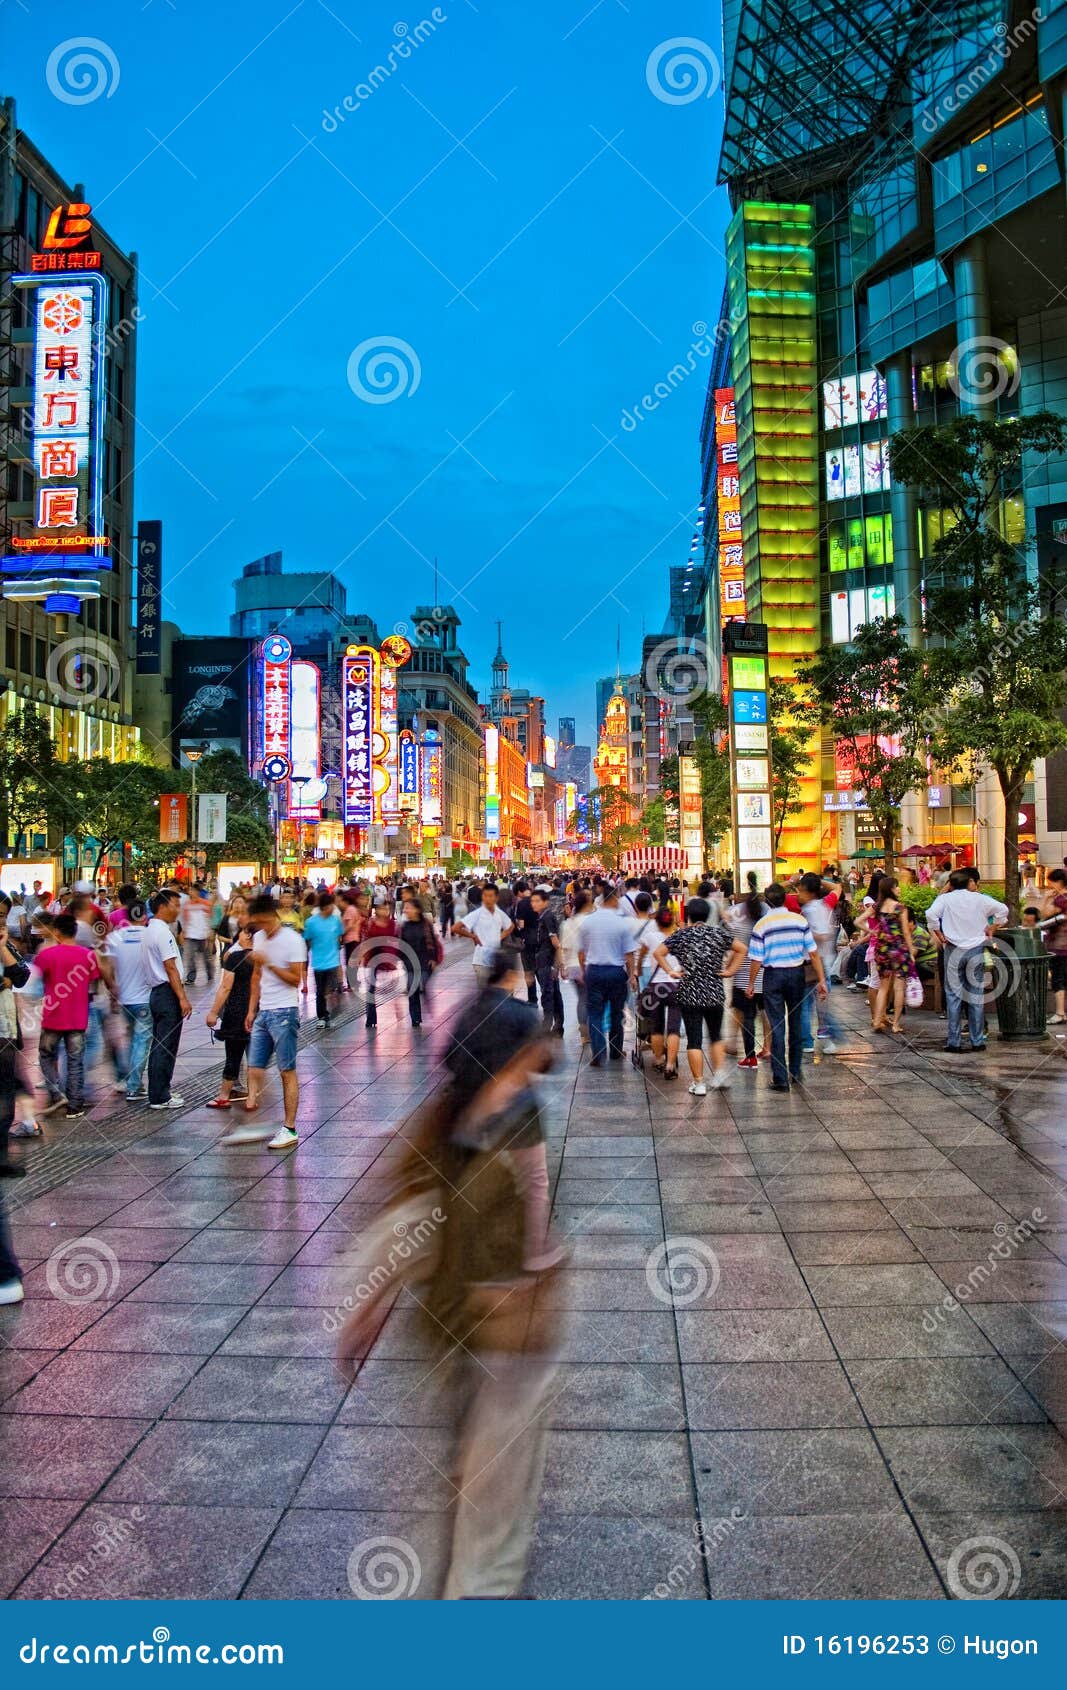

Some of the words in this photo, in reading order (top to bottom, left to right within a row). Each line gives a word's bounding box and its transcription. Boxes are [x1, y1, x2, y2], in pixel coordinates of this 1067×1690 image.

[32, 251, 101, 271] 百联集团
[188, 664, 233, 674] LONGINES
